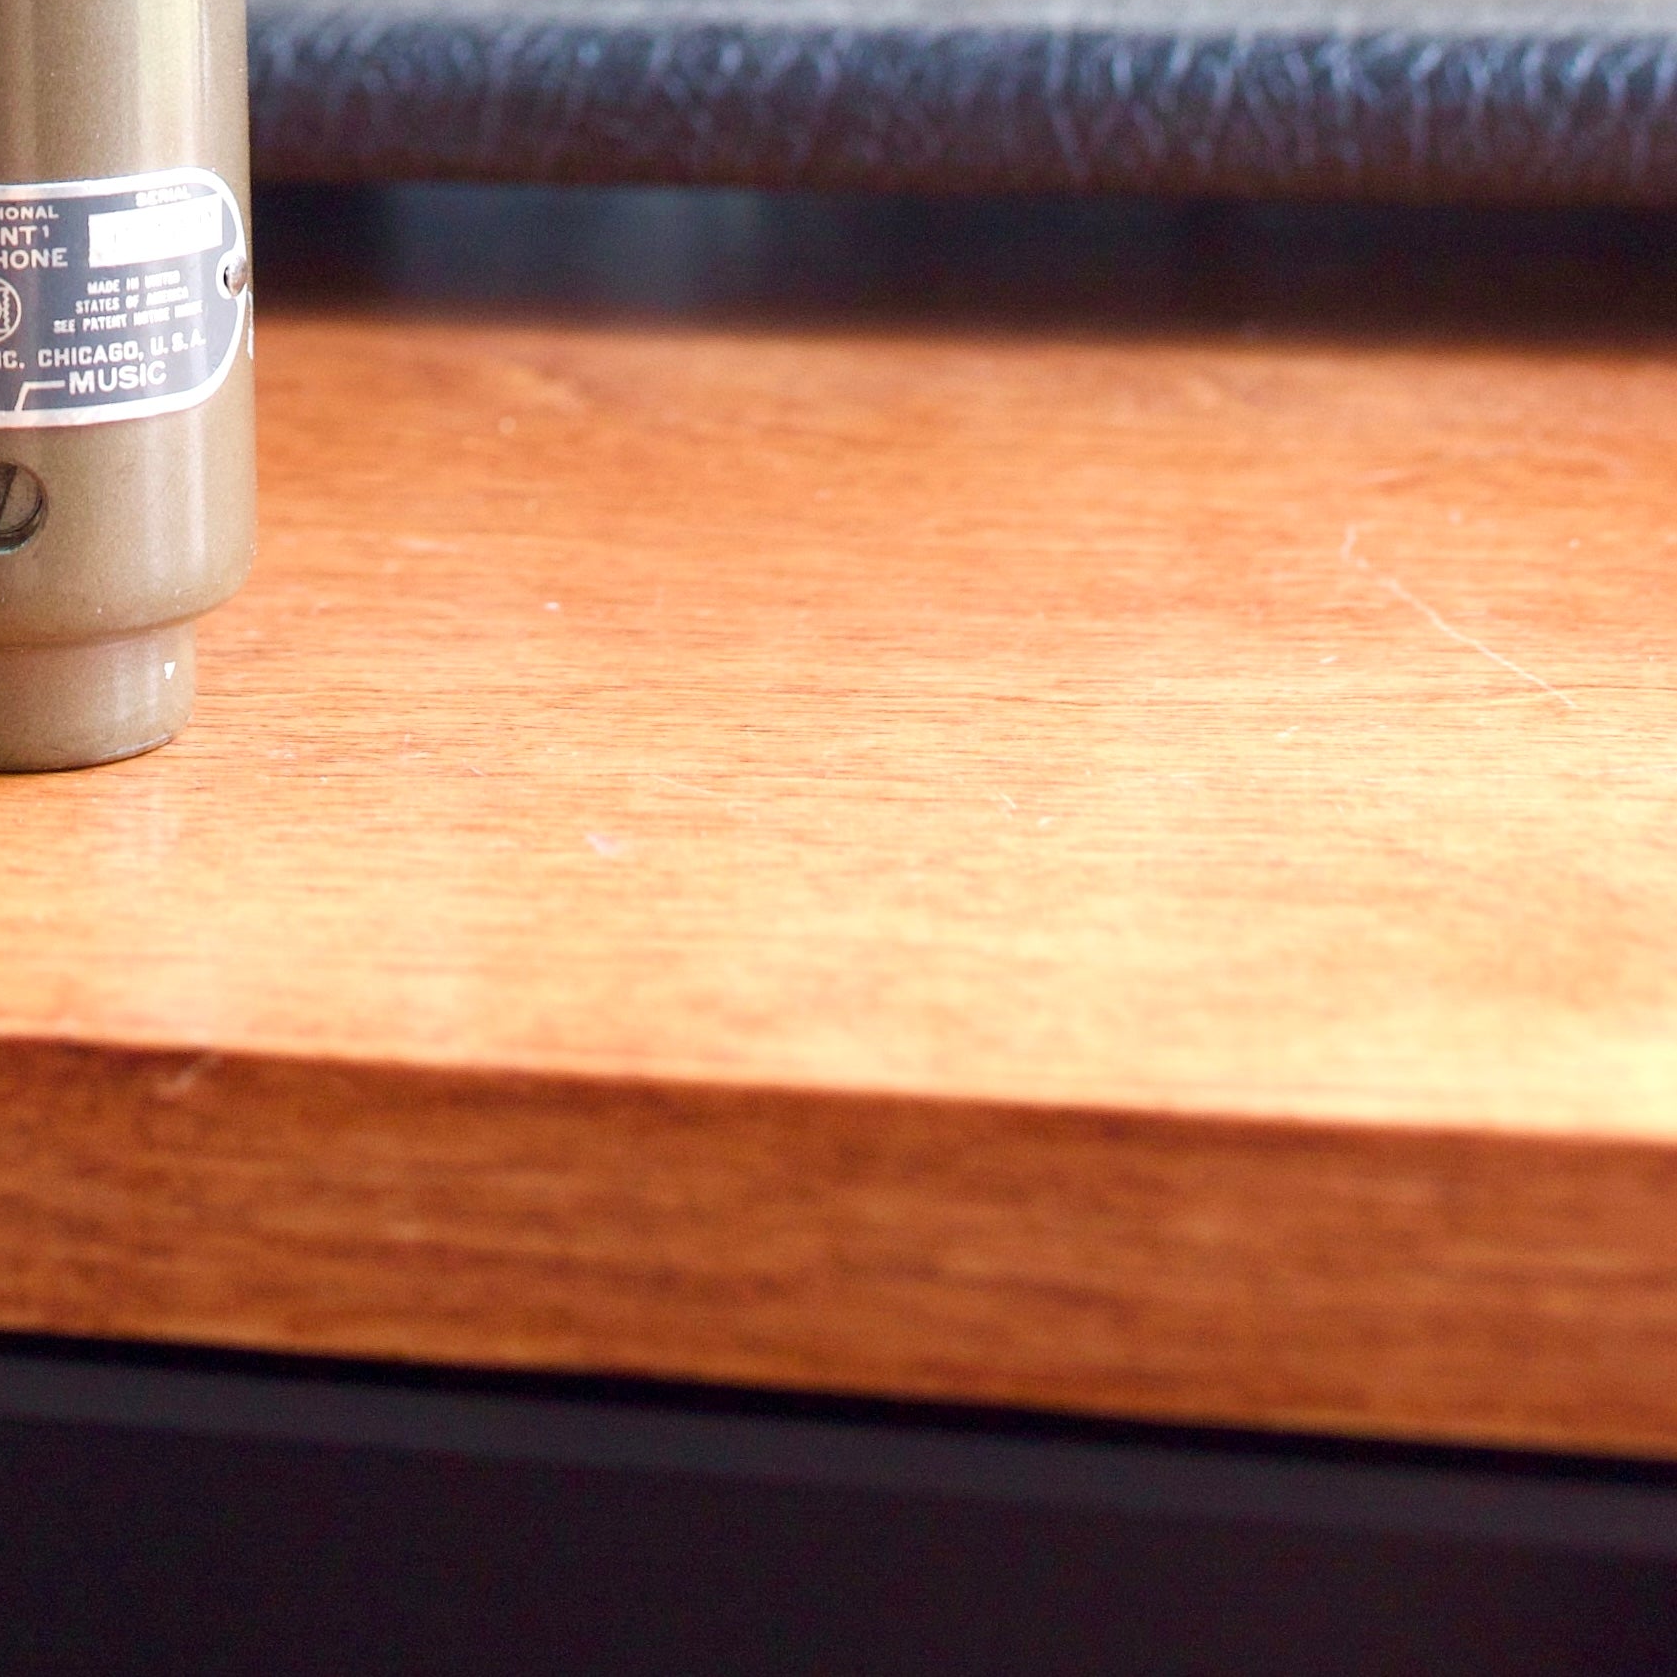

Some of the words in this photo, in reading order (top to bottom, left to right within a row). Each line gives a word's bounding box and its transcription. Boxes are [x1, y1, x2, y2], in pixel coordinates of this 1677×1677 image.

[136, 185, 191, 207] SERIAL
[87, 279, 120, 295] MADE
[126, 276, 140, 291] IN
[75, 297, 120, 315] STATES
[125, 294, 140, 309] OF
[53, 319, 76, 333] SEE
[82, 313, 128, 332] PATENT
[37, 340, 144, 367] CHICAGO,
[69, 360, 167, 395] MUSIC
